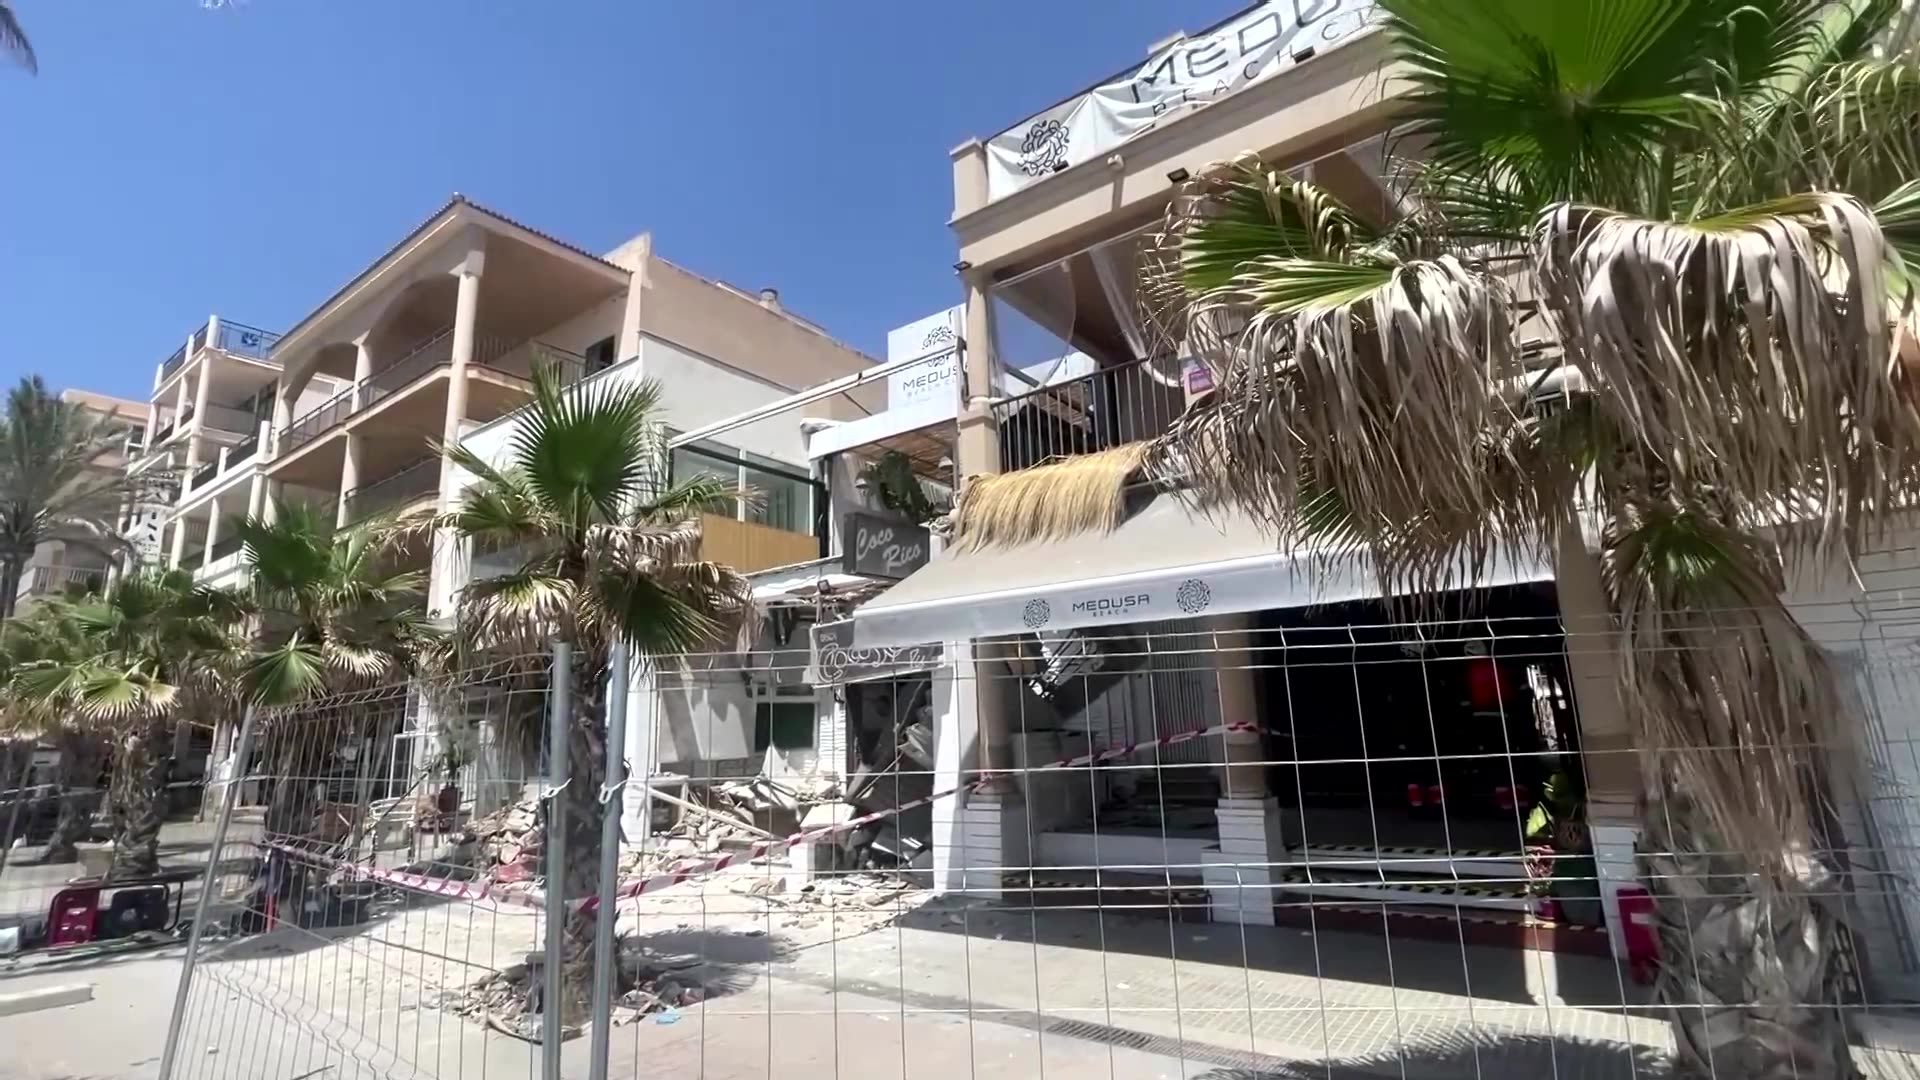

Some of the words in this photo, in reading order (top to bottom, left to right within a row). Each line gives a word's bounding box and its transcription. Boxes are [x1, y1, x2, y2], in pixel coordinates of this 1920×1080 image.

[856, 528, 894, 561] Coco
[882, 544, 921, 574] Rico
[1072, 594, 1150, 613] MEDUSA
[1092, 608, 1129, 618] BEACH
